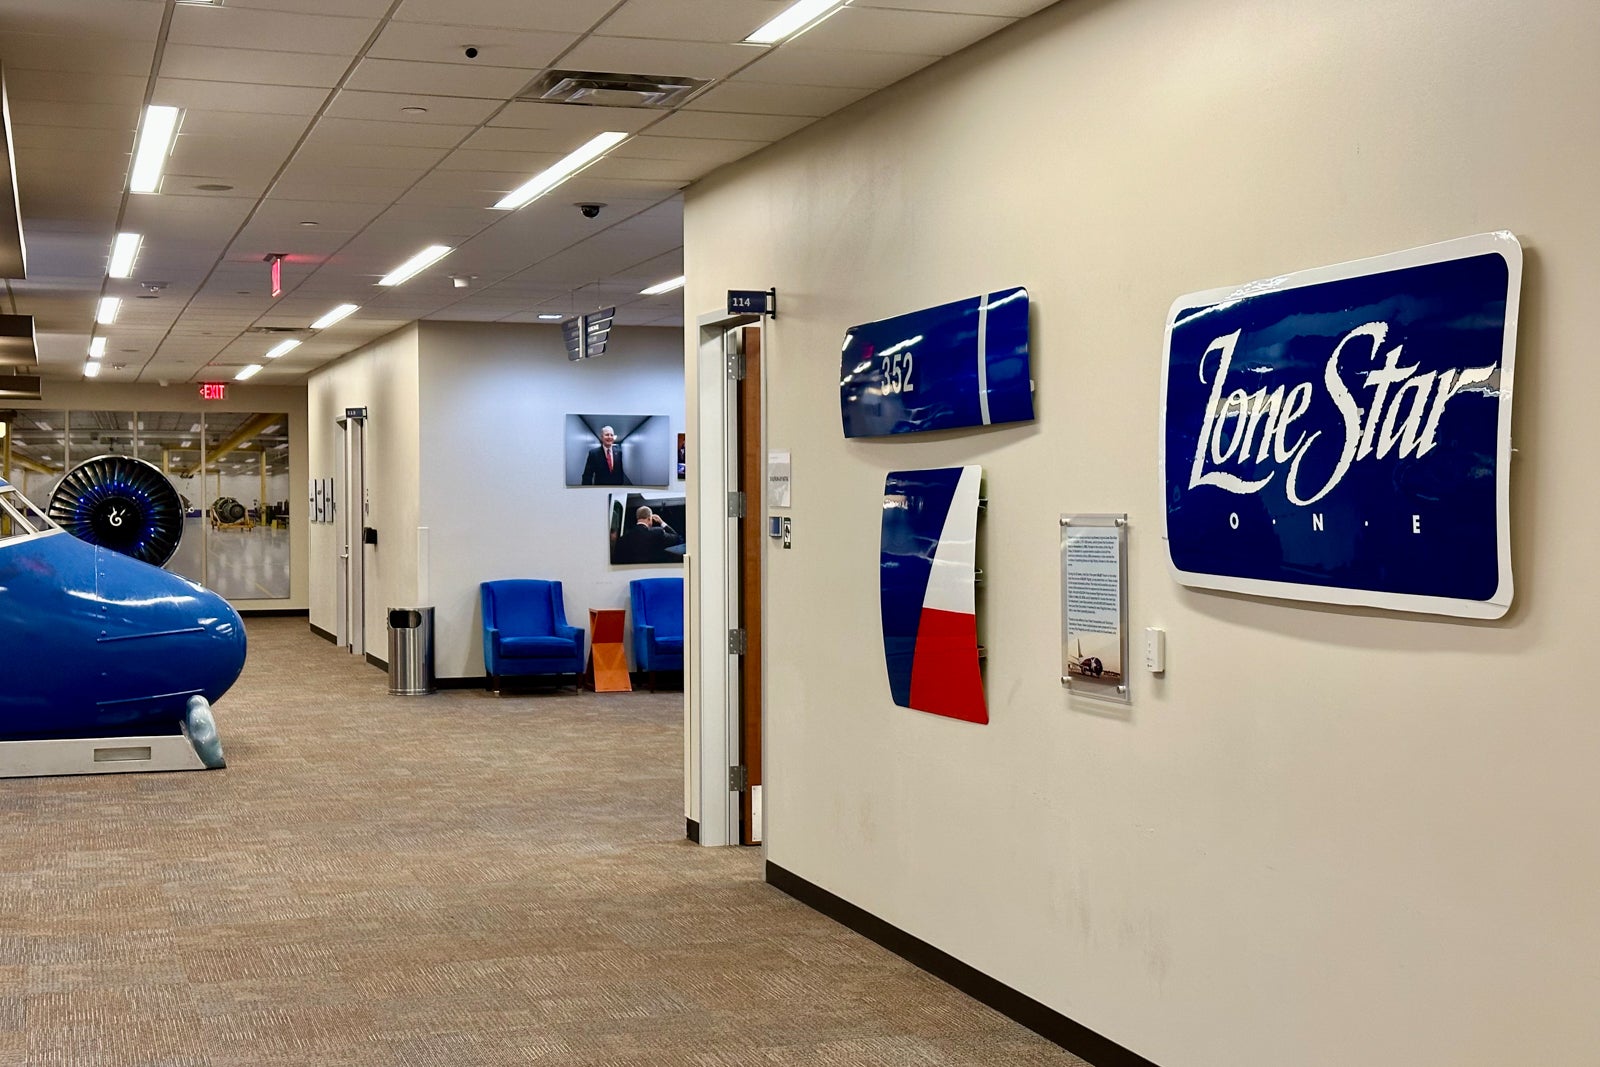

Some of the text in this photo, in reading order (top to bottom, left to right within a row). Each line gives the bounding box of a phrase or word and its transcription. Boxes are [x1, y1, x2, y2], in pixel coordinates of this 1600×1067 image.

[732, 297, 751, 307] 114
[881, 351, 914, 396] 352
[204, 384, 225, 400] EXIT
[1187, 321, 1498, 507] Lone Star
